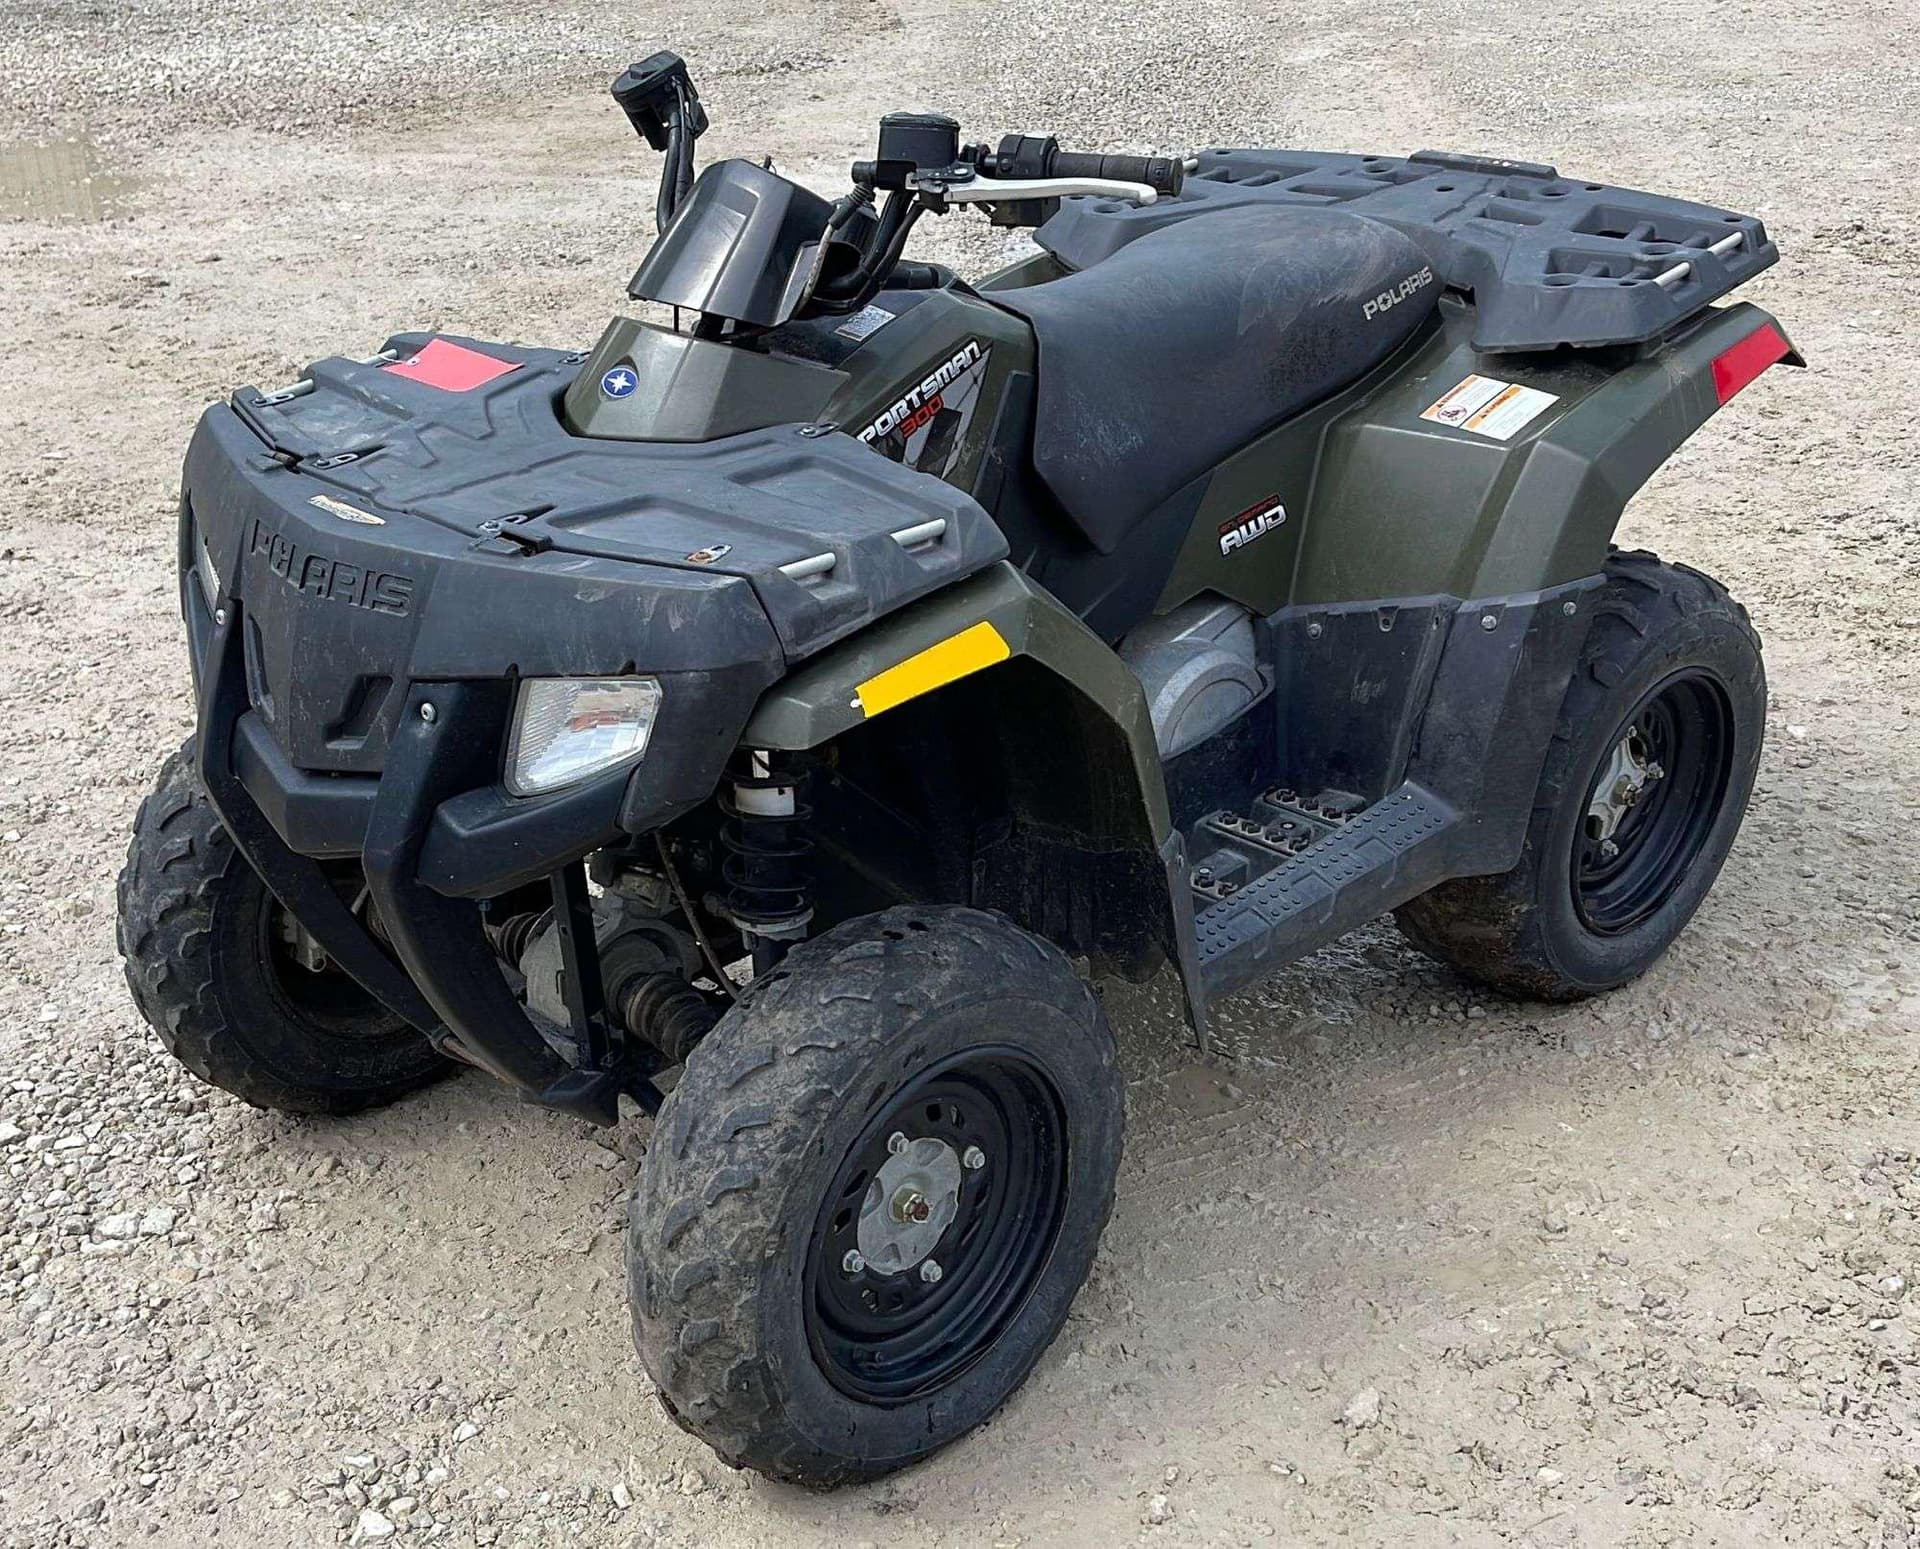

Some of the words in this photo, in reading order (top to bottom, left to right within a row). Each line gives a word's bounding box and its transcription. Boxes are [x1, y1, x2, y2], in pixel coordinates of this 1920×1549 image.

[1362, 265, 1433, 320] POLARIS
[856, 341, 981, 443] PORTSMAN
[900, 394, 942, 438] 300
[1219, 504, 1287, 555] AWD
[251, 518, 413, 618] POLARIS
